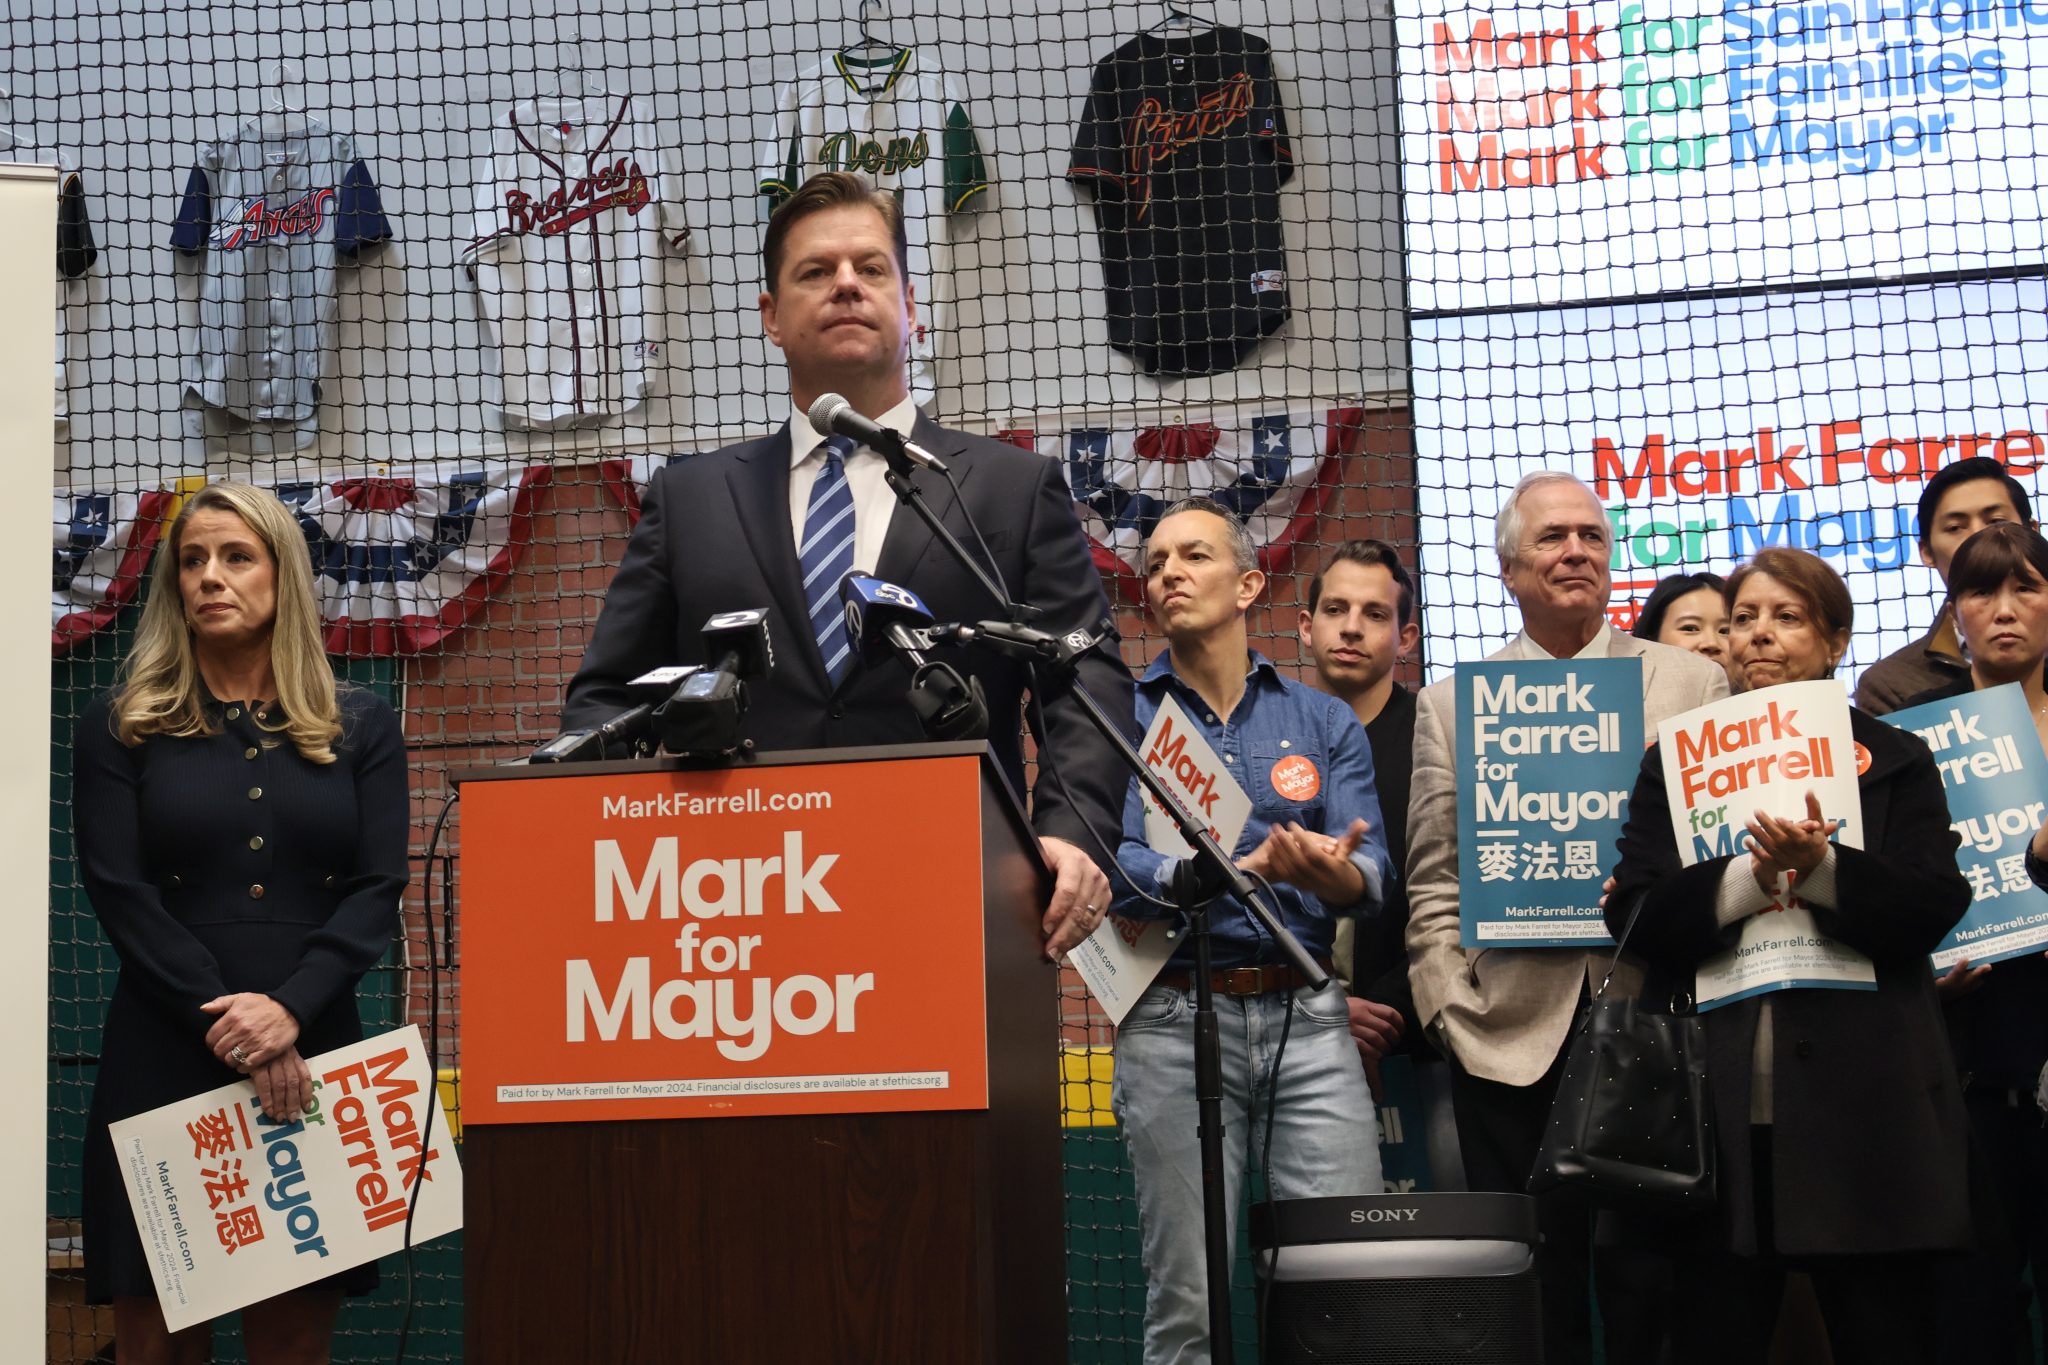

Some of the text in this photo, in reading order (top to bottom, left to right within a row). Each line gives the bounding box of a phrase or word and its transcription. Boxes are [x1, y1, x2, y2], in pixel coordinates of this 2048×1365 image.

[1433, 10, 1607, 76] Mark
[1616, 4, 1713, 60] for
[1724, 0, 1858, 51] San
[1436, 38, 2008, 133] Mark for Families
[1439, 108, 1955, 192] Mark for Mayor
[1592, 409, 2048, 500] Mark Farre
[1606, 494, 1920, 573] for May
[1473, 672, 1595, 715] Mark
[1474, 712, 1620, 756] Farrell
[1675, 701, 1802, 769] Mark
[1893, 708, 1987, 753] ark
[1153, 715, 1220, 819] Mark
[1277, 762, 1307, 780] Mark
[1281, 774, 1314, 792] Mayor
[1475, 757, 1518, 781] for
[1681, 737, 1834, 810] Farrell
[1936, 734, 2024, 788] rrell
[602, 788, 832, 819] MarkFarrell.com
[1475, 781, 1628, 832] Mayor
[1689, 804, 1728, 834] for
[1949, 801, 2045, 853] ayor
[594, 830, 842, 922] Mark
[1477, 841, 1601, 883] 麥法恩
[1960, 853, 2033, 902] 法恩
[1505, 905, 1604, 917] MarkFarrell.com
[675, 922, 762, 973] for
[1087, 934, 1117, 976] arrell.com
[1734, 936, 1834, 960] MarkFarrell.com
[565, 956, 874, 1062] Mayor
[502, 1075, 943, 1099] Paid for by Mark Farrell for Mayor 2024. Financial disclosures are available at sfethics.org.
[365, 1046, 440, 1191] Mark
[322, 1061, 410, 1232] Farrell
[156, 1160, 195, 1271] MarkFarrell.com
[1350, 1209, 1420, 1223] SONY
